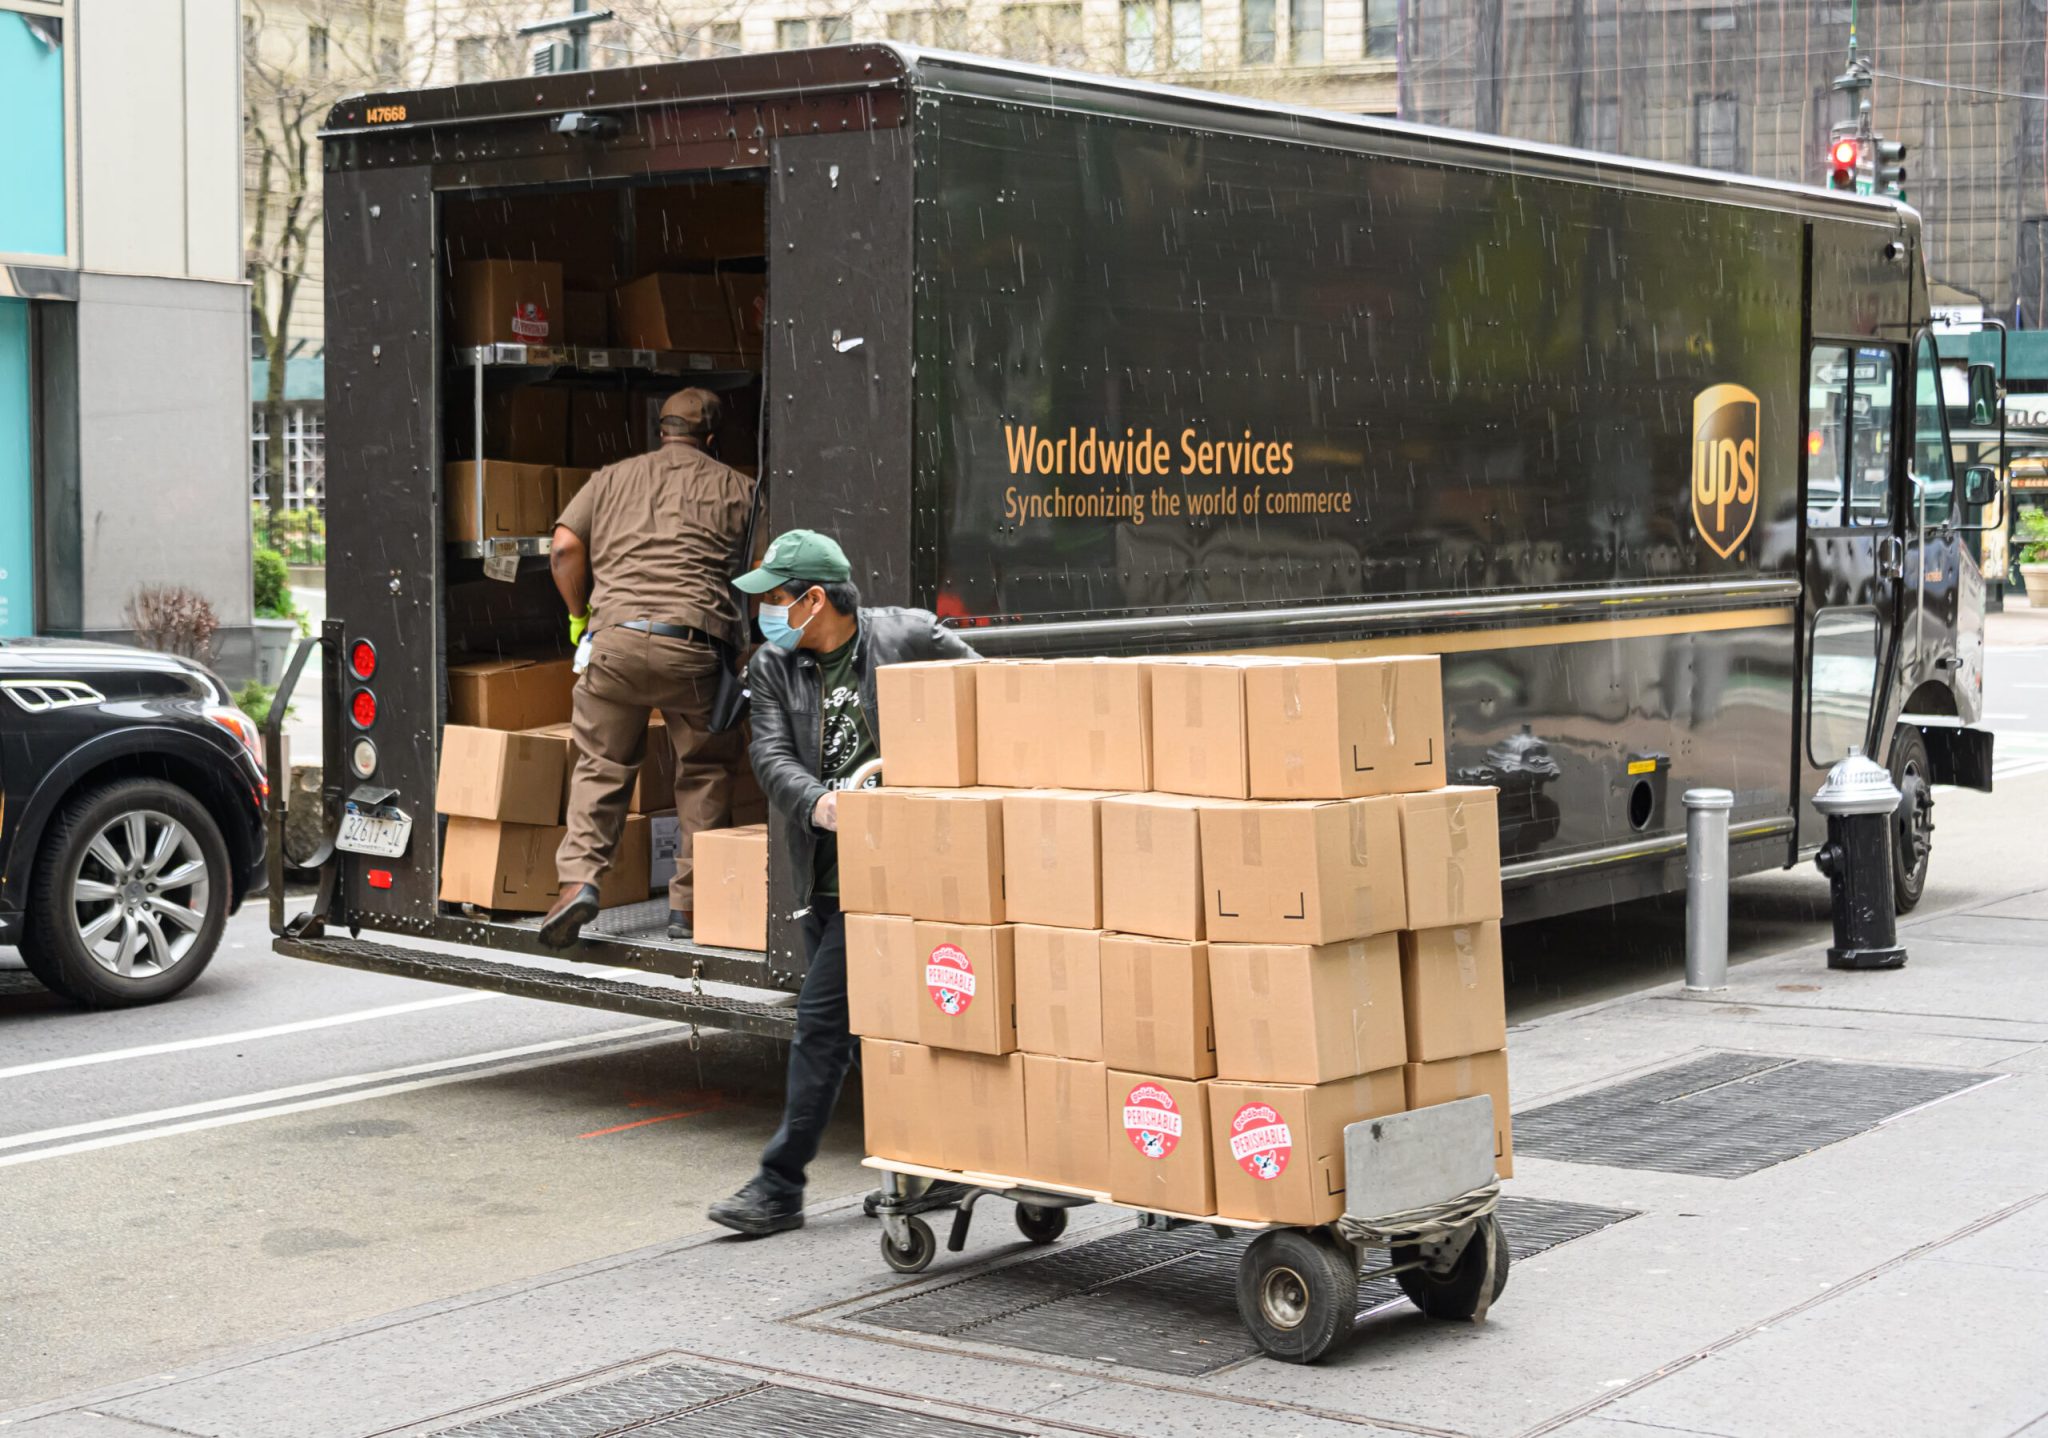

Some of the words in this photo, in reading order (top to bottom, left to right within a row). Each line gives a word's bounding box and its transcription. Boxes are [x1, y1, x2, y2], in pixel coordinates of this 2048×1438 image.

[366, 104, 407, 124] 147668
[1004, 425, 1171, 475] Worldwide
[1180, 428, 1294, 475] Services
[1697, 437, 1754, 532] ups
[1005, 486, 1145, 526] Synchronizing
[1151, 487, 1180, 516] the
[1187, 486, 1238, 516] world
[1243, 485, 1261, 515] of
[1266, 490, 1351, 515] commerce
[927, 967, 973, 992] PERISHABLE
[1126, 1109, 1179, 1133] PERISHABLE
[1233, 1127, 1287, 1156] PERISHABLE
